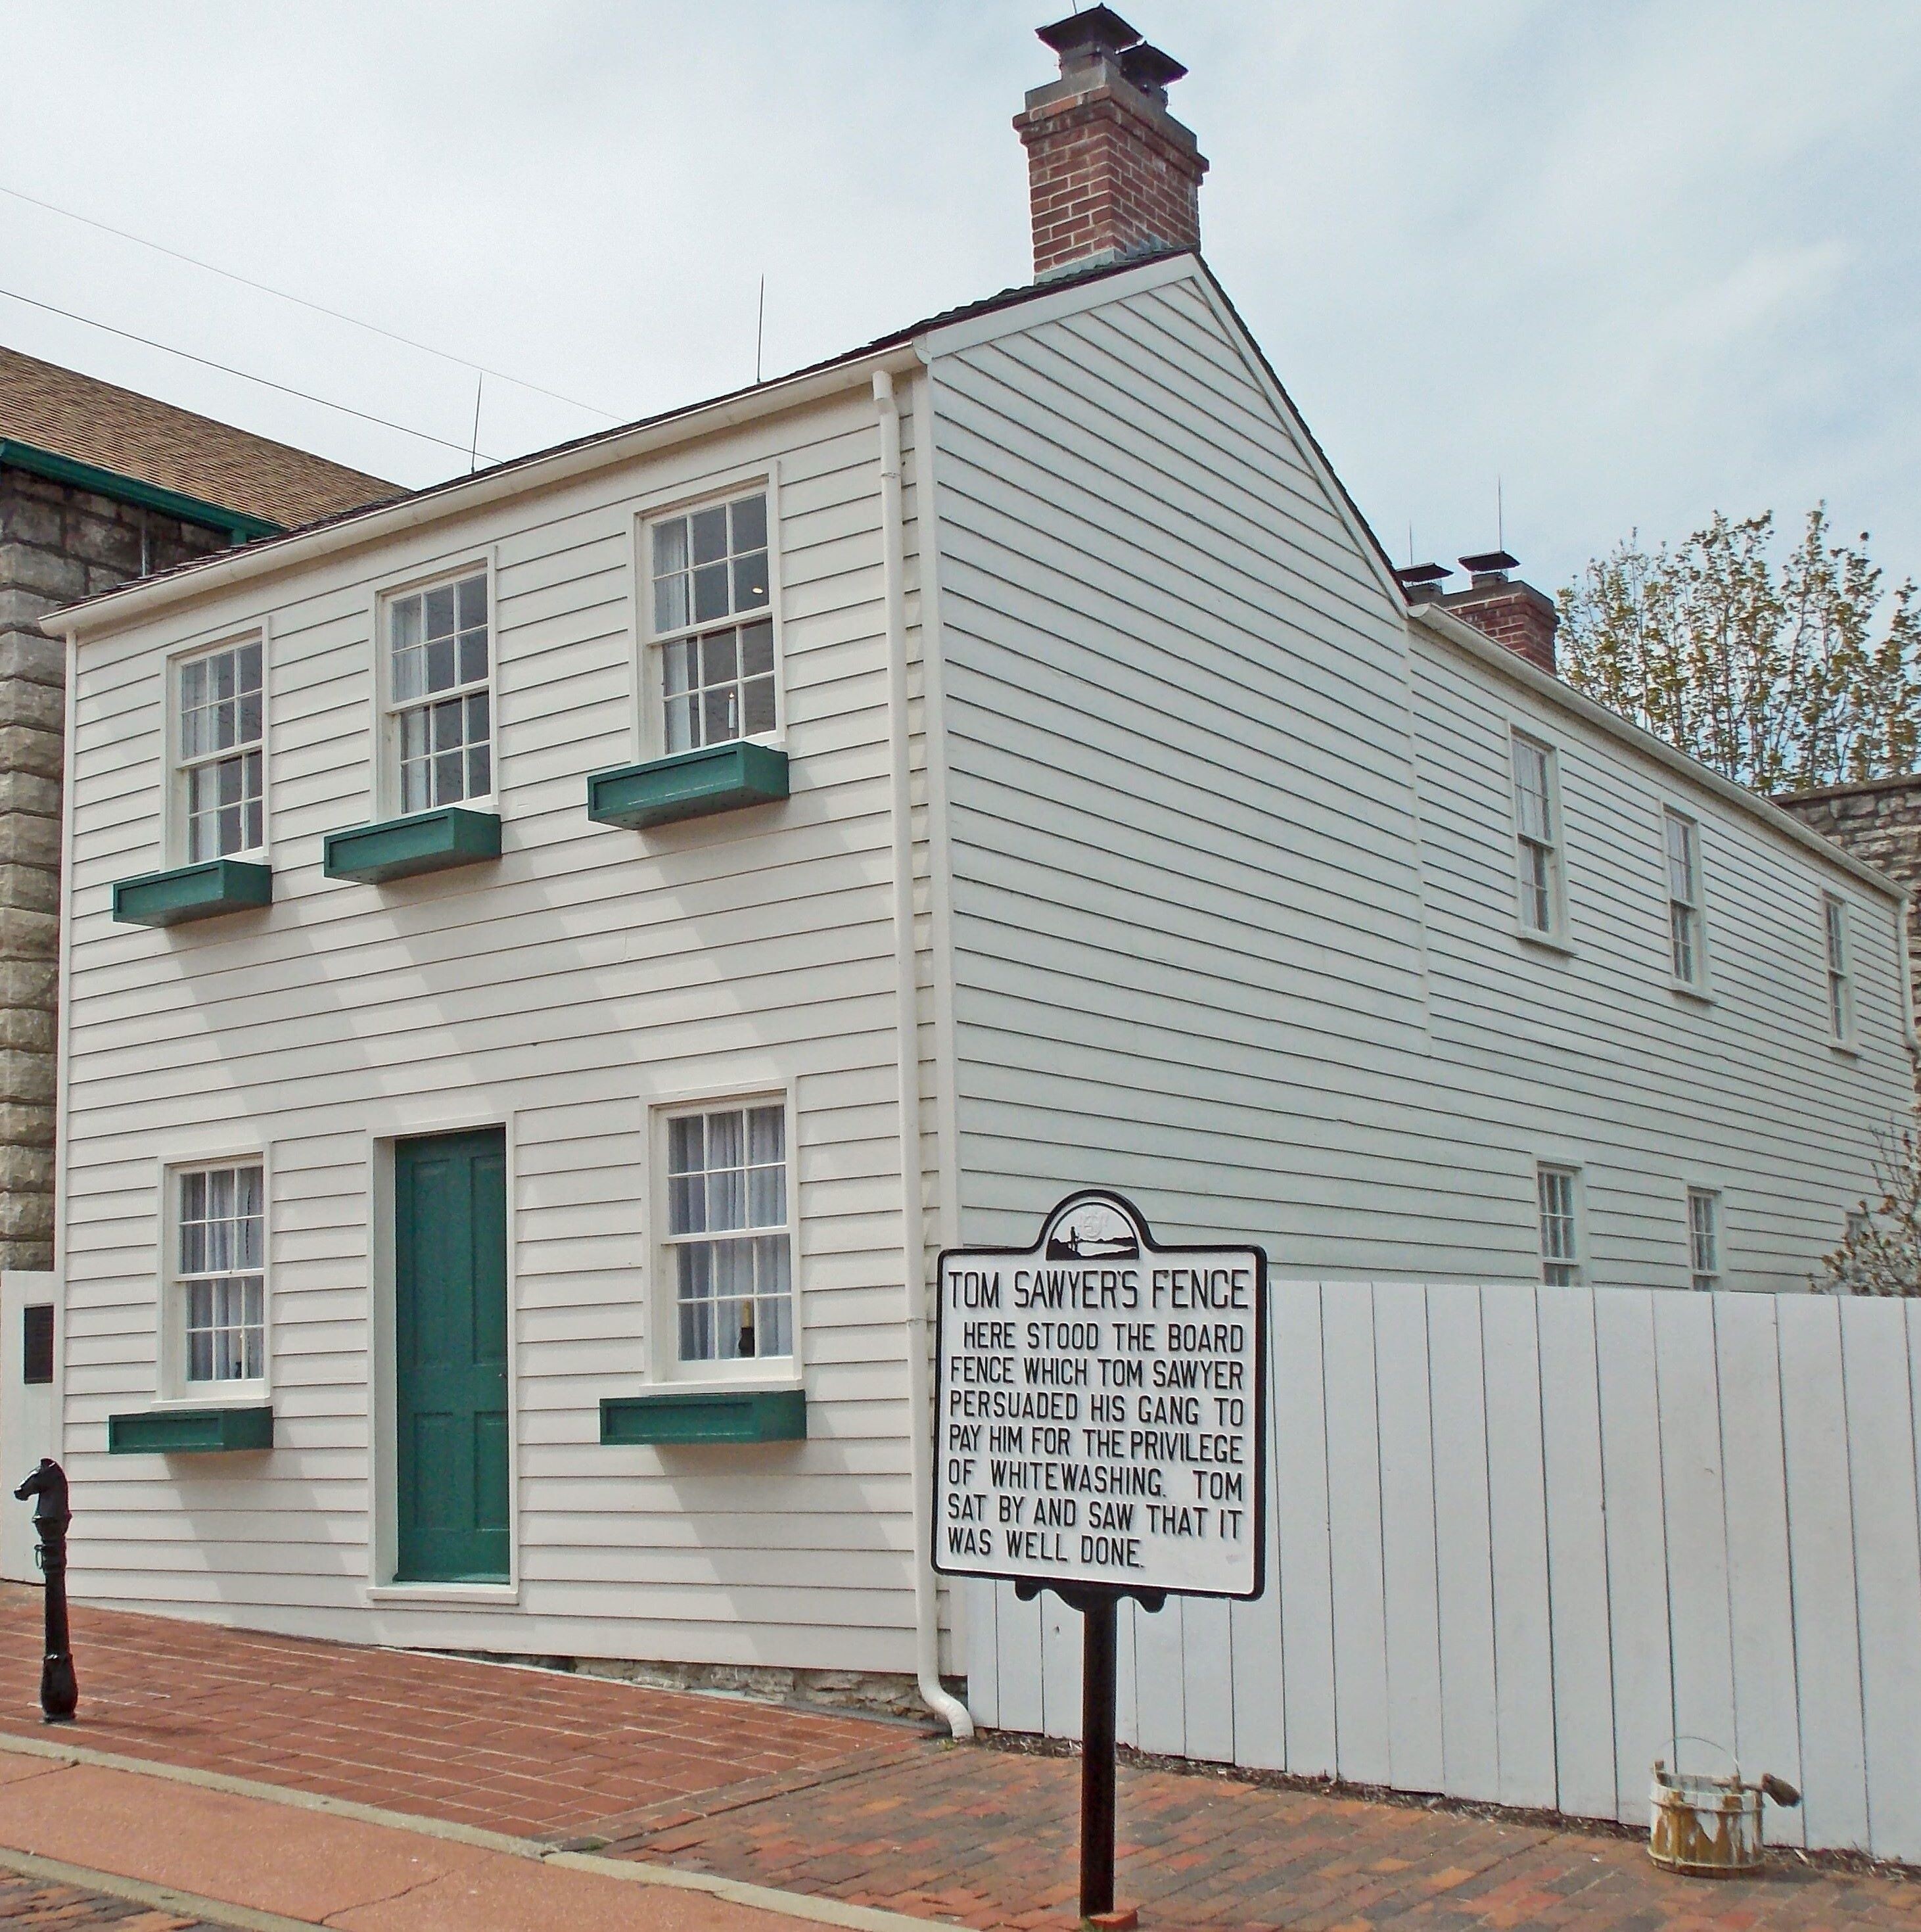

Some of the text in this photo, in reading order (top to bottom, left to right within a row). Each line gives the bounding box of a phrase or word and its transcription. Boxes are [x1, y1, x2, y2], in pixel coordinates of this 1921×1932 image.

[948, 1269, 1249, 1310] TOM SAWYER'S FENCE
[963, 1321, 1243, 1354] HERE STOOD THE BOARD
[950, 1355, 1243, 1390] FENCE WHICH TOM SAWYER
[950, 1390, 1243, 1427] PERSUADED HIS GANG TO
[949, 1424, 1243, 1465] PAY HIM FOR THE PRIVILEGE
[948, 1458, 1242, 1502] OF WHITEWASHING. TOM
[948, 1493, 1243, 1540] SAT BY AND SAW THAT IT
[948, 1526, 1144, 1568] WAS WELL DONE.
